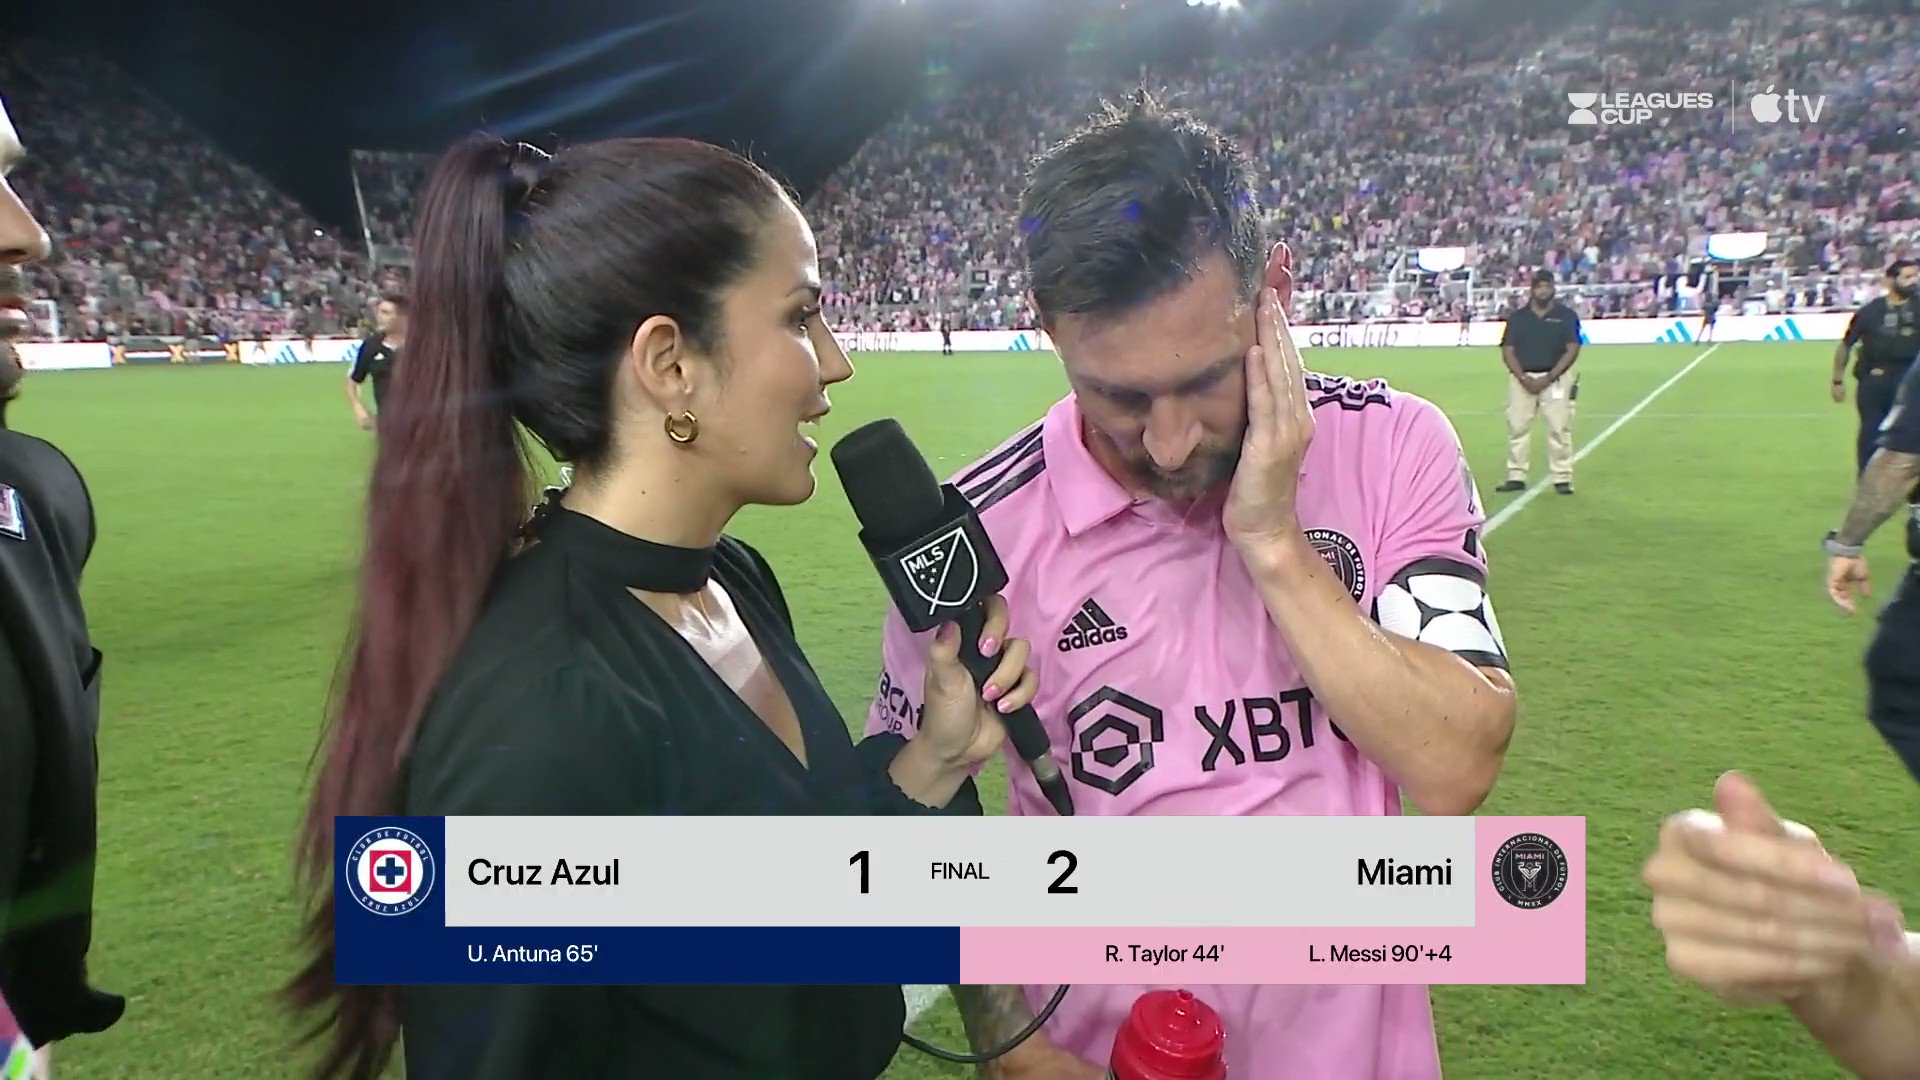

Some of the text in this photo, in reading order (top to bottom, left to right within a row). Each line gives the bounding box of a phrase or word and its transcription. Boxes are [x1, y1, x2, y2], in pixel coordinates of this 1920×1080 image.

[907, 546, 945, 574] MLS
[1057, 626, 1128, 652] adidas
[1194, 687, 1349, 772] XBT
